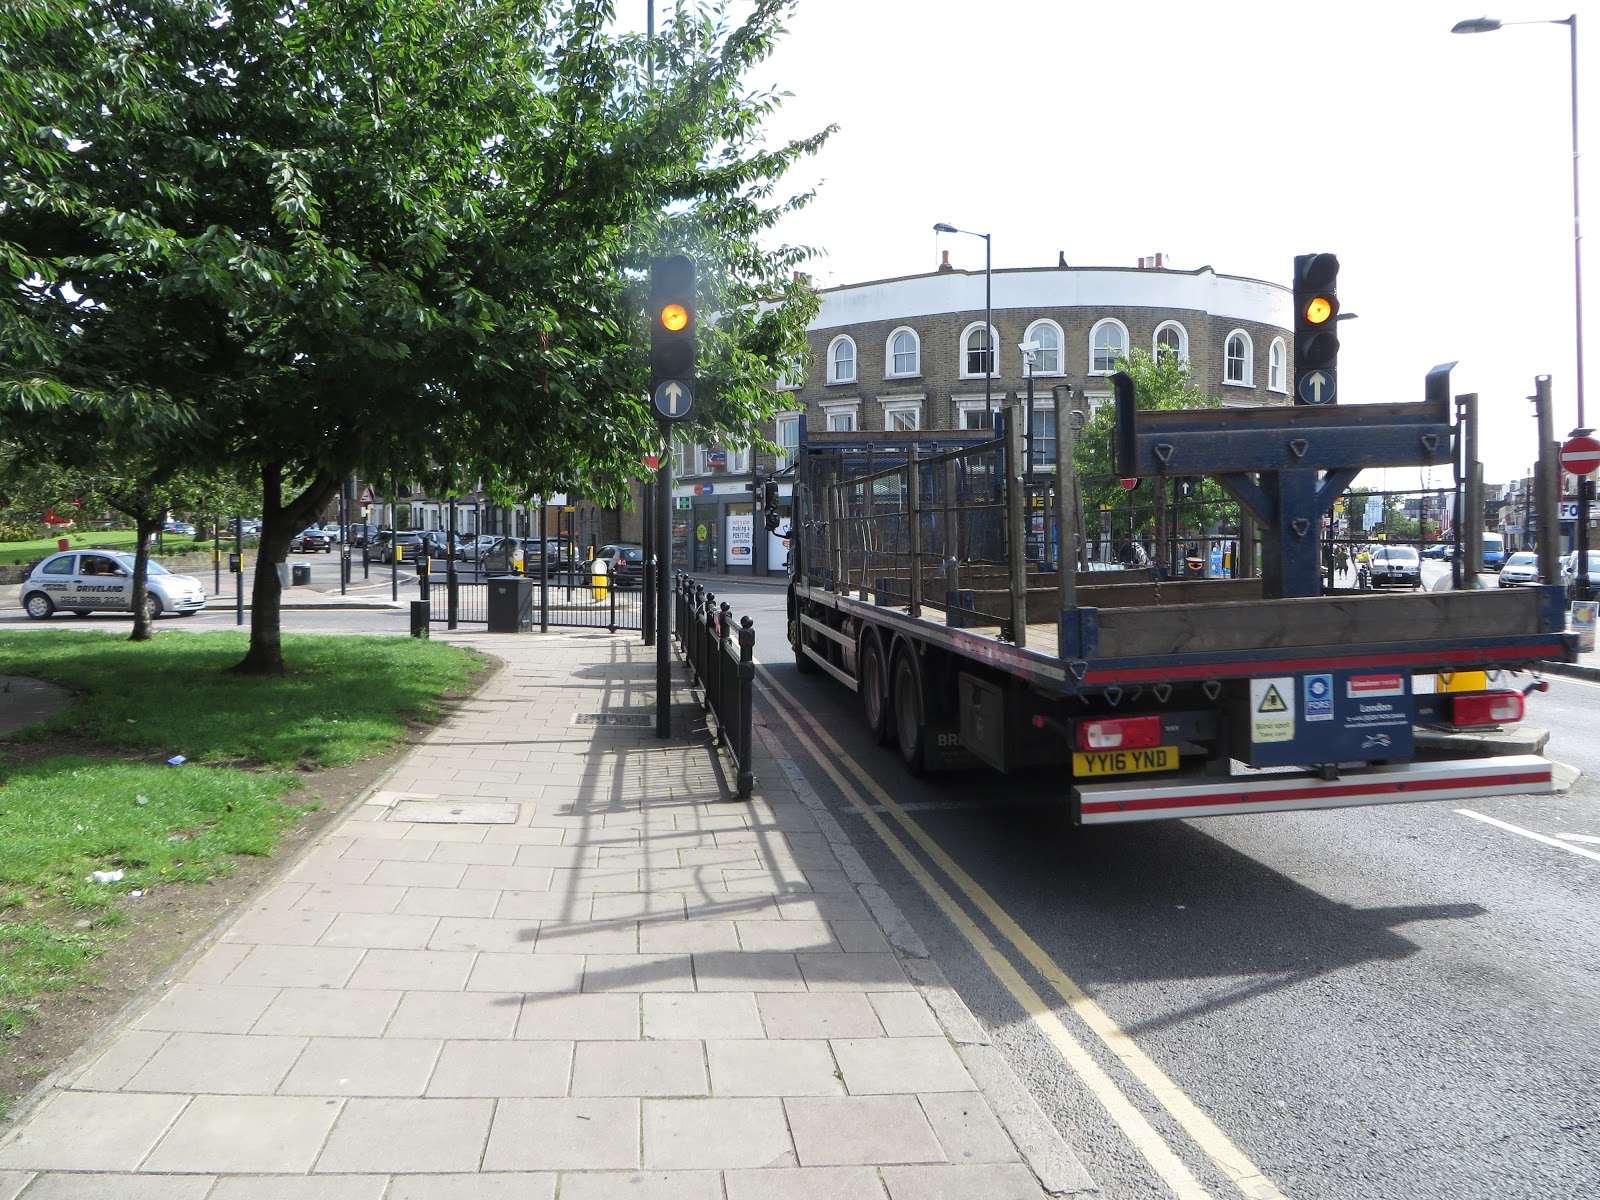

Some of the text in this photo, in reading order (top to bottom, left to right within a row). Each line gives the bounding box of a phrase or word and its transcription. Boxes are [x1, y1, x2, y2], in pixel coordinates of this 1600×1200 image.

[76, 585, 124, 593] DRIVELAND
[1308, 701, 1331, 709] FORS
[1359, 702, 1393, 713] London
[1256, 722, 1290, 730] Blind spot
[1085, 749, 1167, 773] YY16 YND
